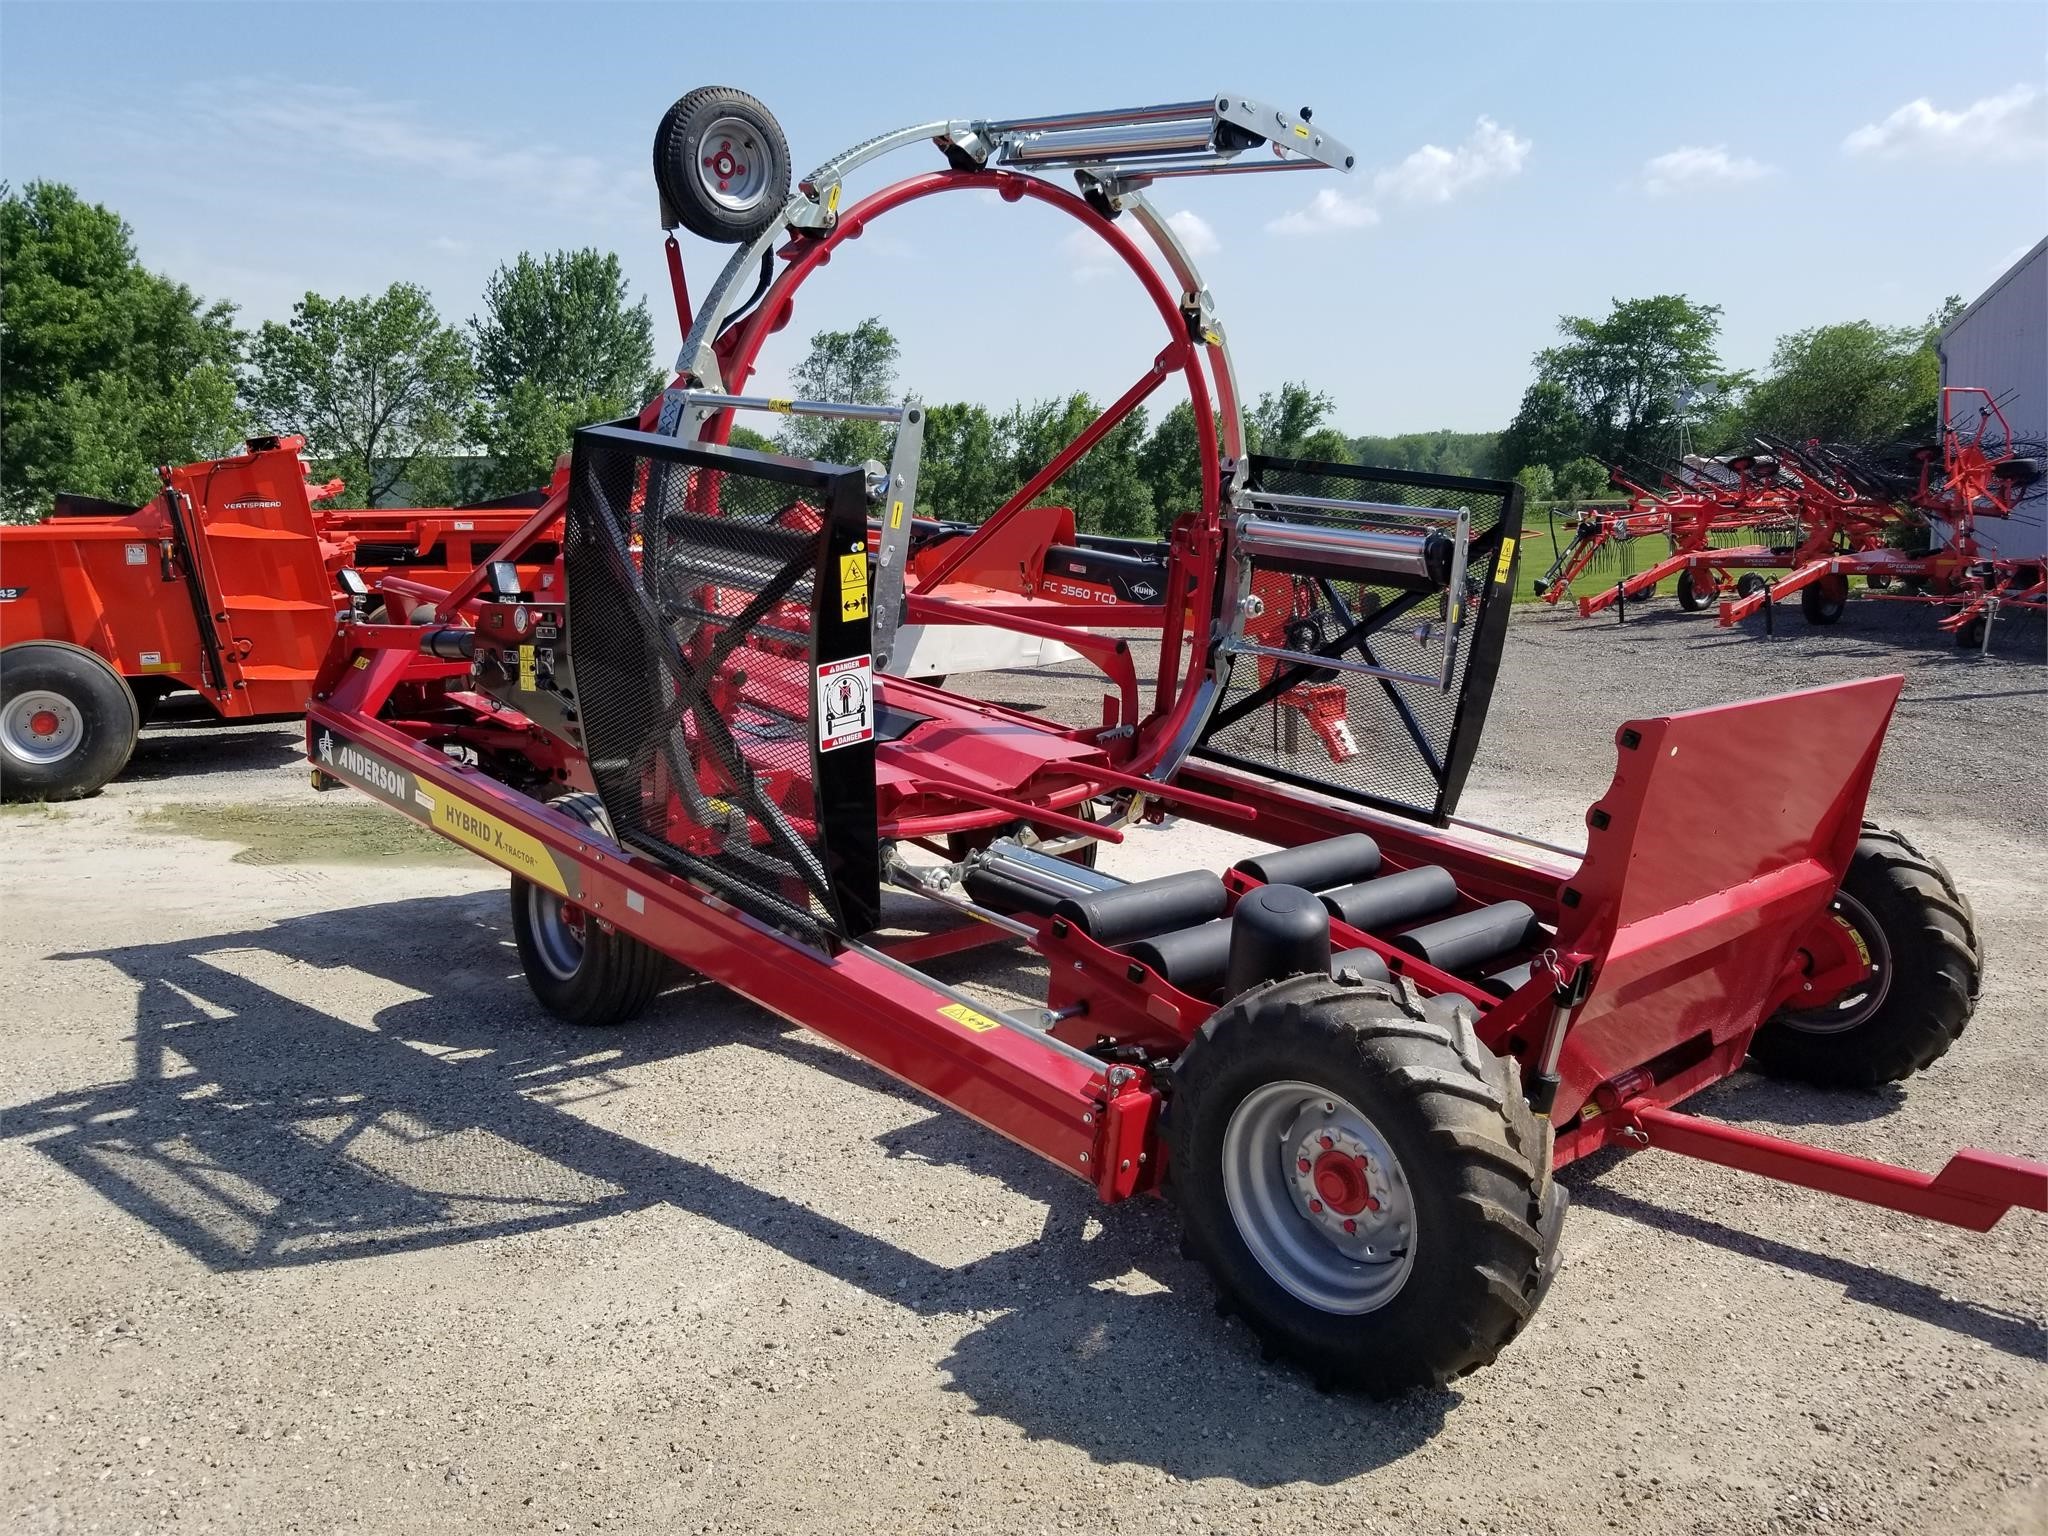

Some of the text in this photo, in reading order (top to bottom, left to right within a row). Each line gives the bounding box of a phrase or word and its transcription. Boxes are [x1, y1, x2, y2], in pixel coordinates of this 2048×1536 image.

[223, 501, 282, 510] VERTISPREAD
[1043, 581, 1117, 605] FC 3560 TCD
[1134, 586, 1154, 597] KUHN
[835, 660, 860, 672] DANGER
[838, 732, 863, 744] DANGER
[338, 746, 405, 800] ANDERSON
[446, 804, 491, 843] HYBRID
